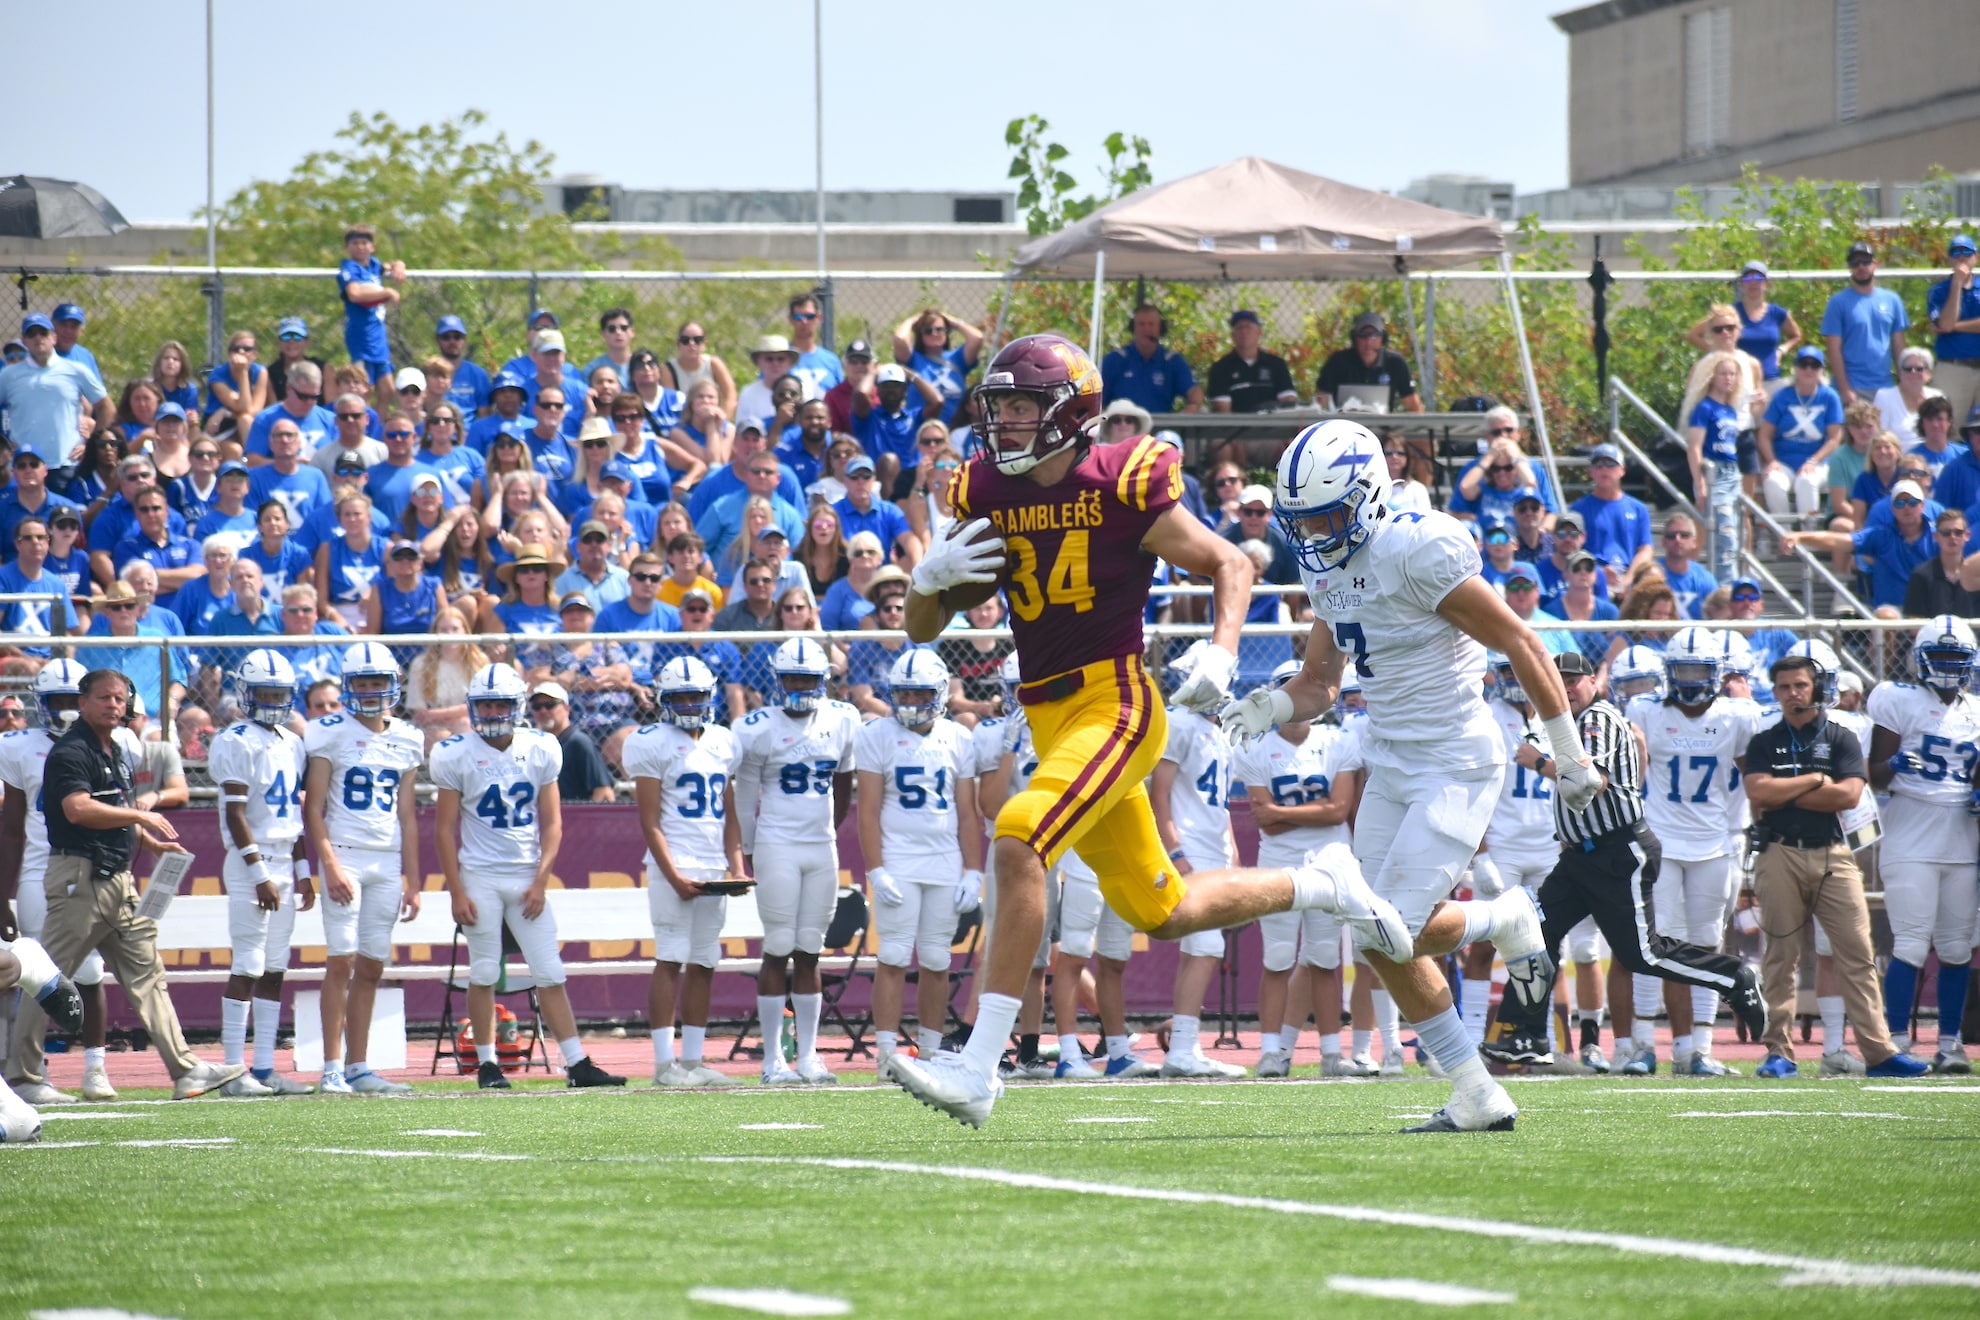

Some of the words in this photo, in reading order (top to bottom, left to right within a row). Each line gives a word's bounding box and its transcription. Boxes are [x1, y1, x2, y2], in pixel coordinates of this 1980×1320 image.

[1782, 404, 1826, 441] X
[268, 489, 309, 530] X
[991, 502, 1103, 534] RAMBLERS
[1007, 529, 1096, 622] 34
[1335, 622, 1375, 678] 7
[780, 760, 838, 795] 85
[1667, 755, 1718, 803] 17
[1918, 734, 1979, 784] 53
[344, 766, 399, 812] 83
[476, 781, 534, 829] 42
[676, 772, 727, 819] 30
[895, 766, 948, 810] 51
